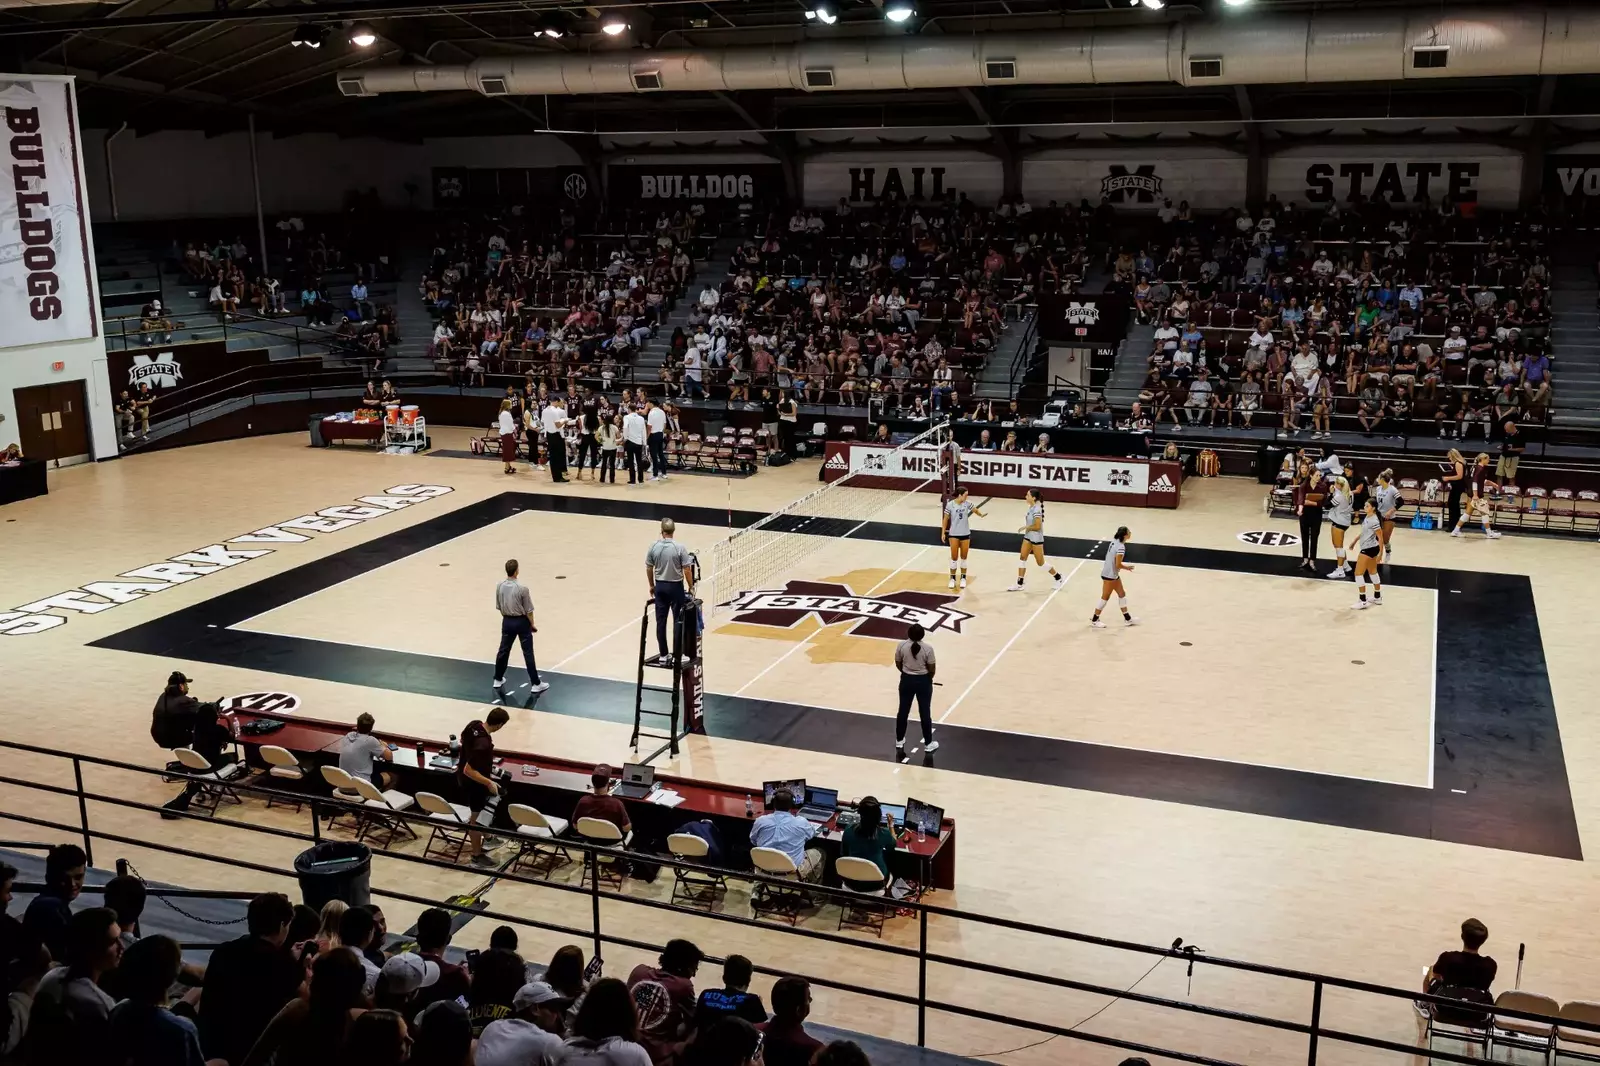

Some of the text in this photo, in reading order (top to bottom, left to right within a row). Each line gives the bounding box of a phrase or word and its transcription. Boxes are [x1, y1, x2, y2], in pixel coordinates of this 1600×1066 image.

[564, 175, 587, 198] SEC
[641, 174, 753, 199] BULLDOG
[849, 167, 956, 203] HAIL
[1111, 175, 1152, 190] STATE
[1305, 162, 1480, 203] STATE
[6, 106, 63, 321] BULLDOGS
[1071, 308, 1094, 318] STATE
[138, 364, 172, 378] STATE
[825, 461, 849, 471] adidas
[902, 456, 1022, 478] MISSSIPPI
[1029, 464, 1091, 483] STATE
[1149, 484, 1176, 493] adidas
[1242, 531, 1301, 546] SEC
[767, 596, 928, 623] STATE
[693, 678, 704, 720] HAIL
